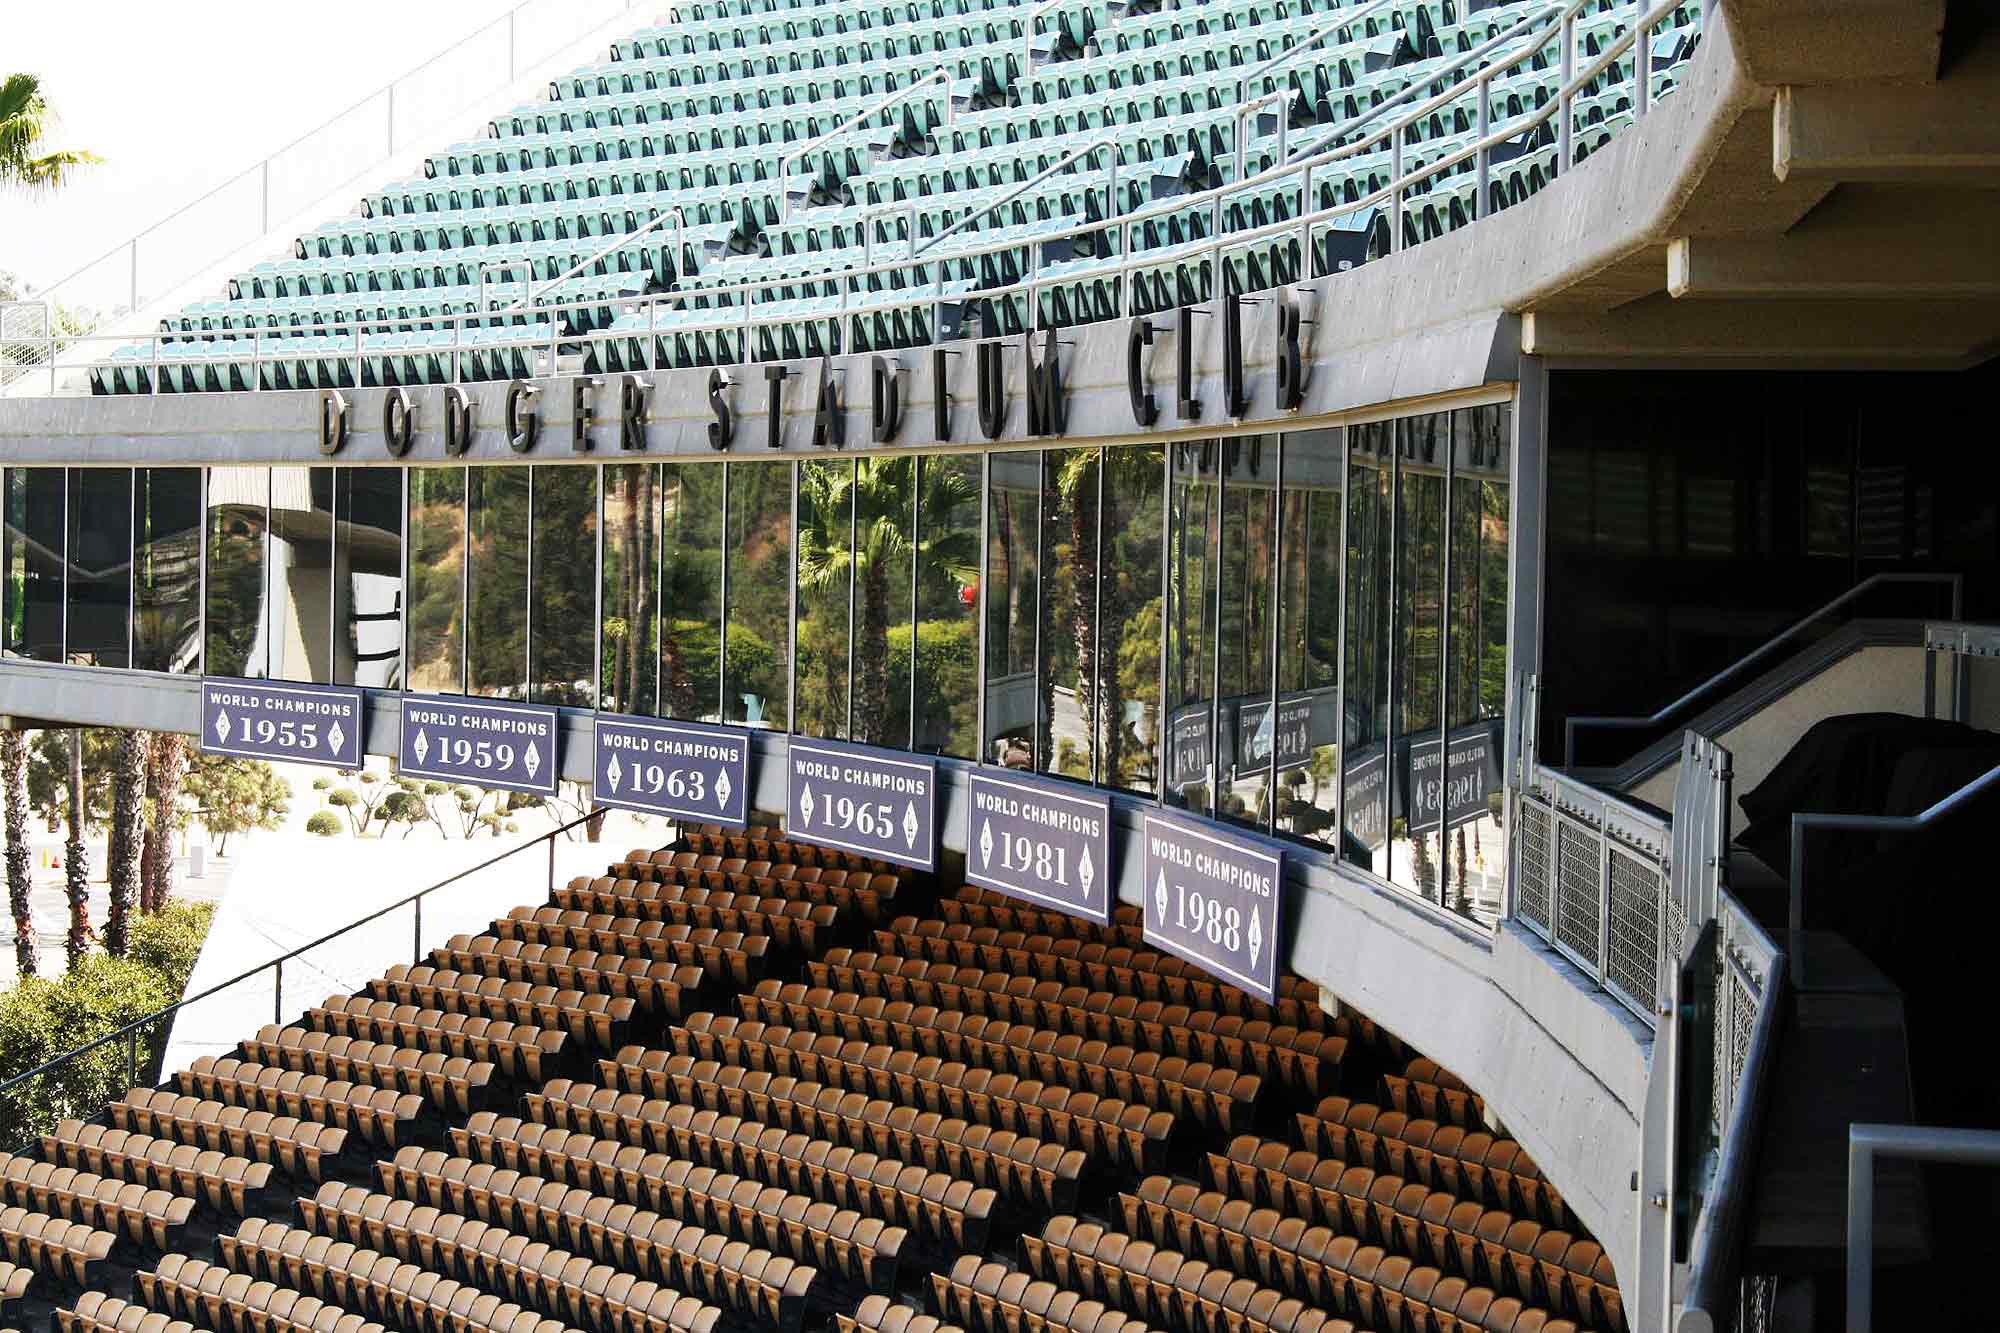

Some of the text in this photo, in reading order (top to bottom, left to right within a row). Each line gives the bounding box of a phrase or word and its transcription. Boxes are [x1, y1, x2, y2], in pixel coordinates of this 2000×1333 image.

[319, 284, 1302, 457] DODGER STADIUM CLUB
[210, 692, 352, 717] WORLD CHAMPIONS
[409, 710, 548, 736] WORLD CHAMPIONS
[239, 717, 319, 749] 1955
[602, 732, 739, 763] WORLD CHAMPIONS
[437, 736, 515, 771] 1959
[630, 763, 705, 801] 1963
[796, 760, 926, 796] WORLD CHAMPIONS
[821, 793, 895, 839] 1965
[976, 791, 1100, 838] WORLD CHAMPIONS
[1000, 831, 1070, 886] 1981
[1151, 837, 1192, 867] WORLD
[1195, 849, 1271, 898] CHAMPIONS
[1175, 885, 1241, 953] 1988
